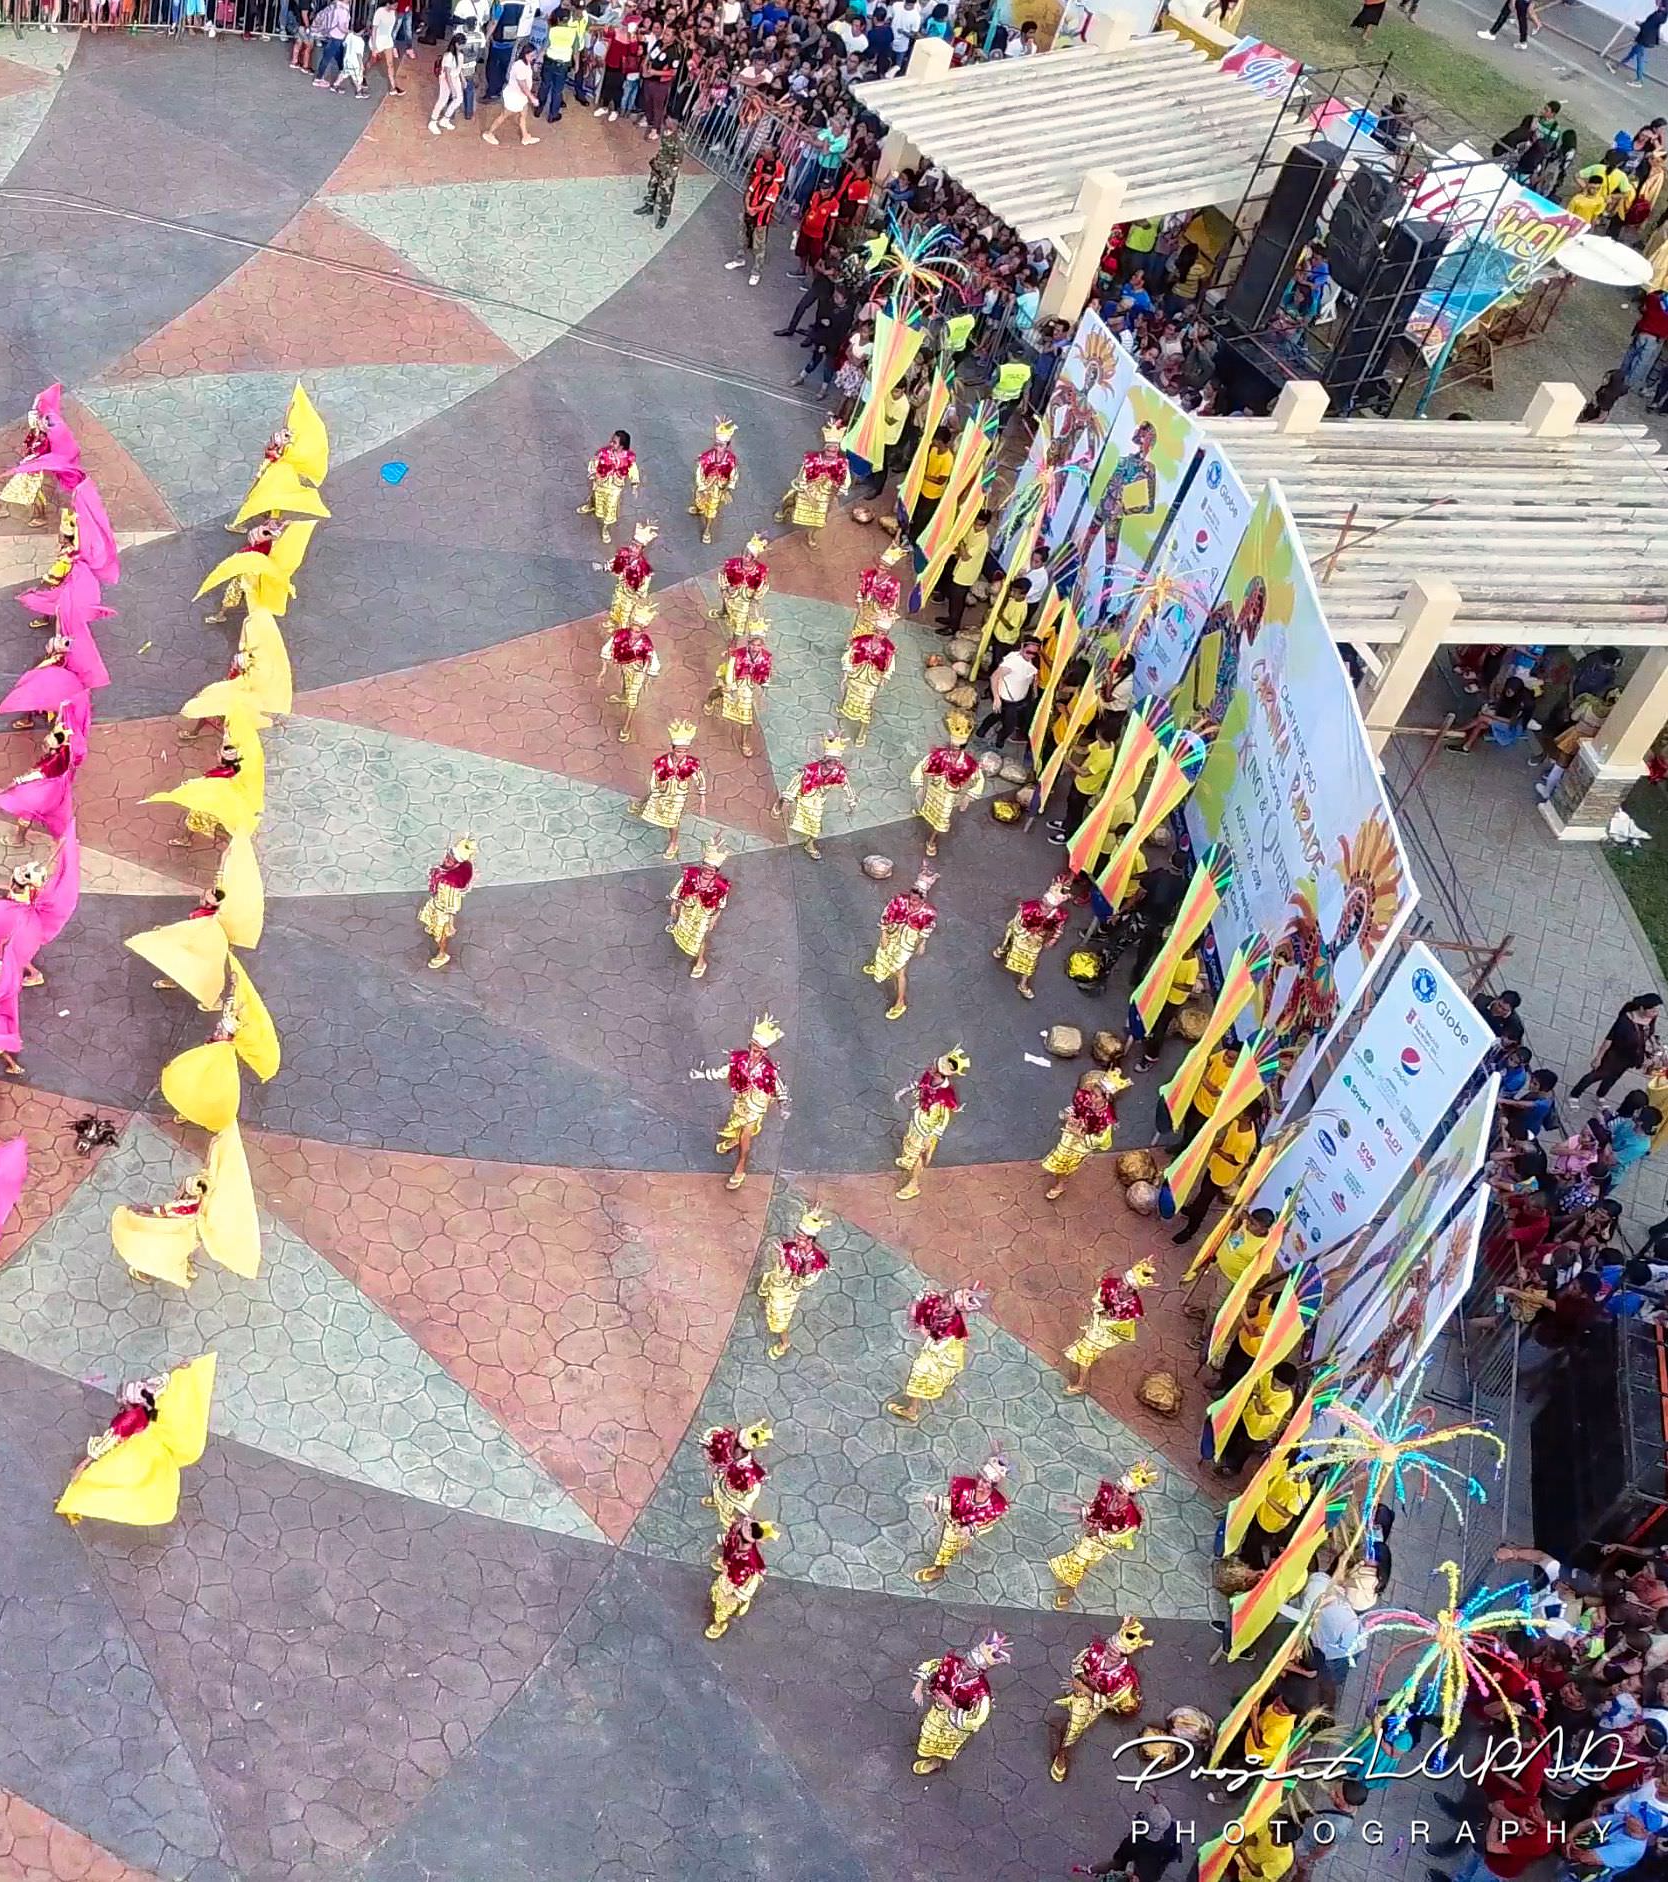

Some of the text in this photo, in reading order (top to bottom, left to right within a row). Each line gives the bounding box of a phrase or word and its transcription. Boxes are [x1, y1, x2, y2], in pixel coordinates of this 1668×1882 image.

[1219, 484, 1238, 518] Globe
[1238, 731, 1265, 798] KING
[1261, 811, 1293, 902] QUEEN
[1436, 1000, 1469, 1046] Globe
[1350, 1084, 1372, 1115] Smart
[1359, 1141, 1377, 1167] true
[1383, 1127, 1404, 1153] PLDT
